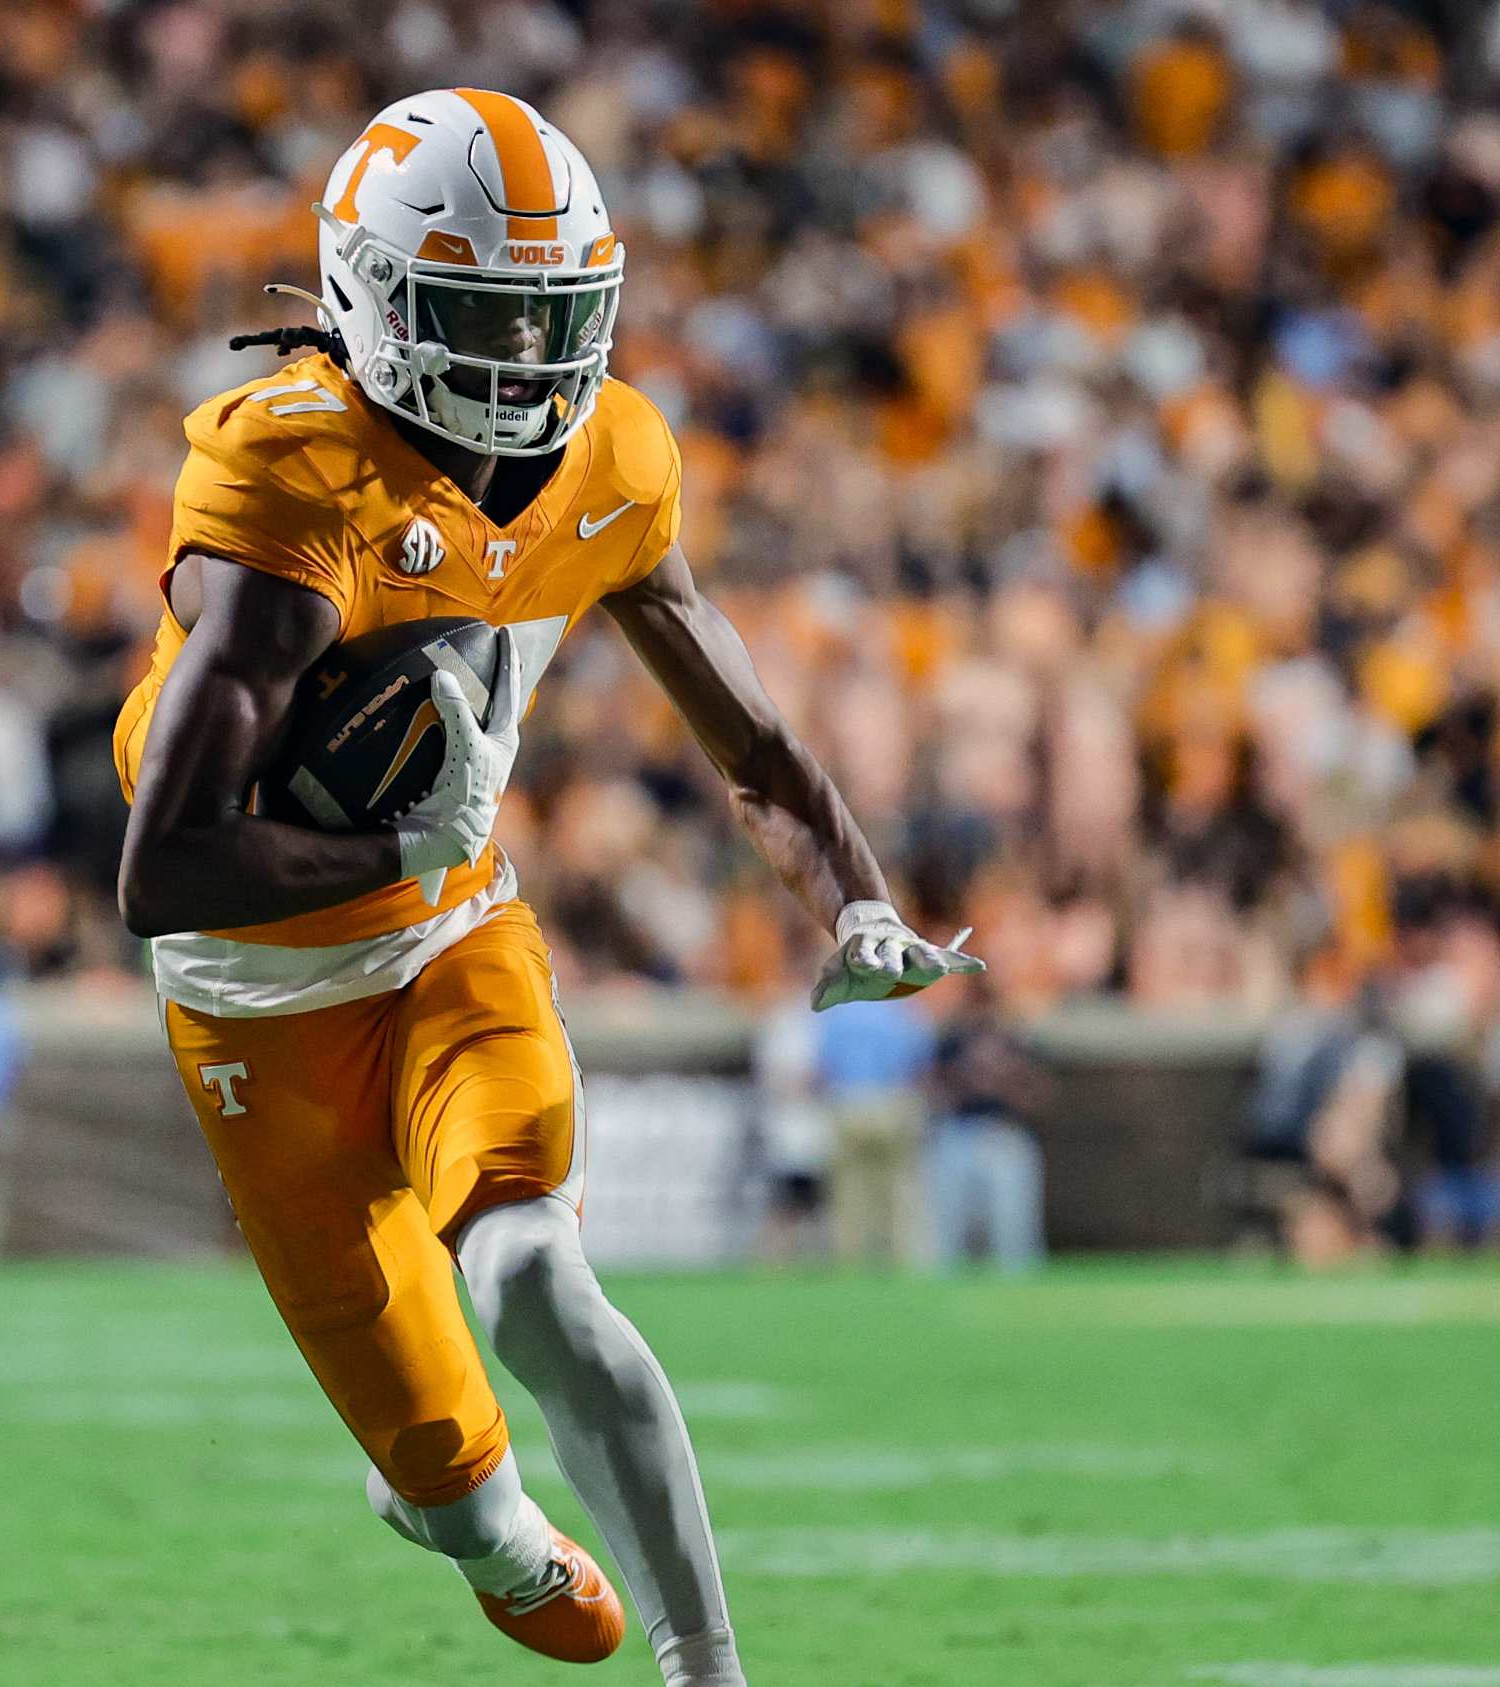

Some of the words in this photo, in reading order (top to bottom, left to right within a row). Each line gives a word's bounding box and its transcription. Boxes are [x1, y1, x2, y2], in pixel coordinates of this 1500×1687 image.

[333, 123, 421, 225] T
[508, 245, 565, 266] VOLS
[246, 380, 349, 417] 17
[485, 540, 518, 578] T
[199, 1061, 248, 1117] T
